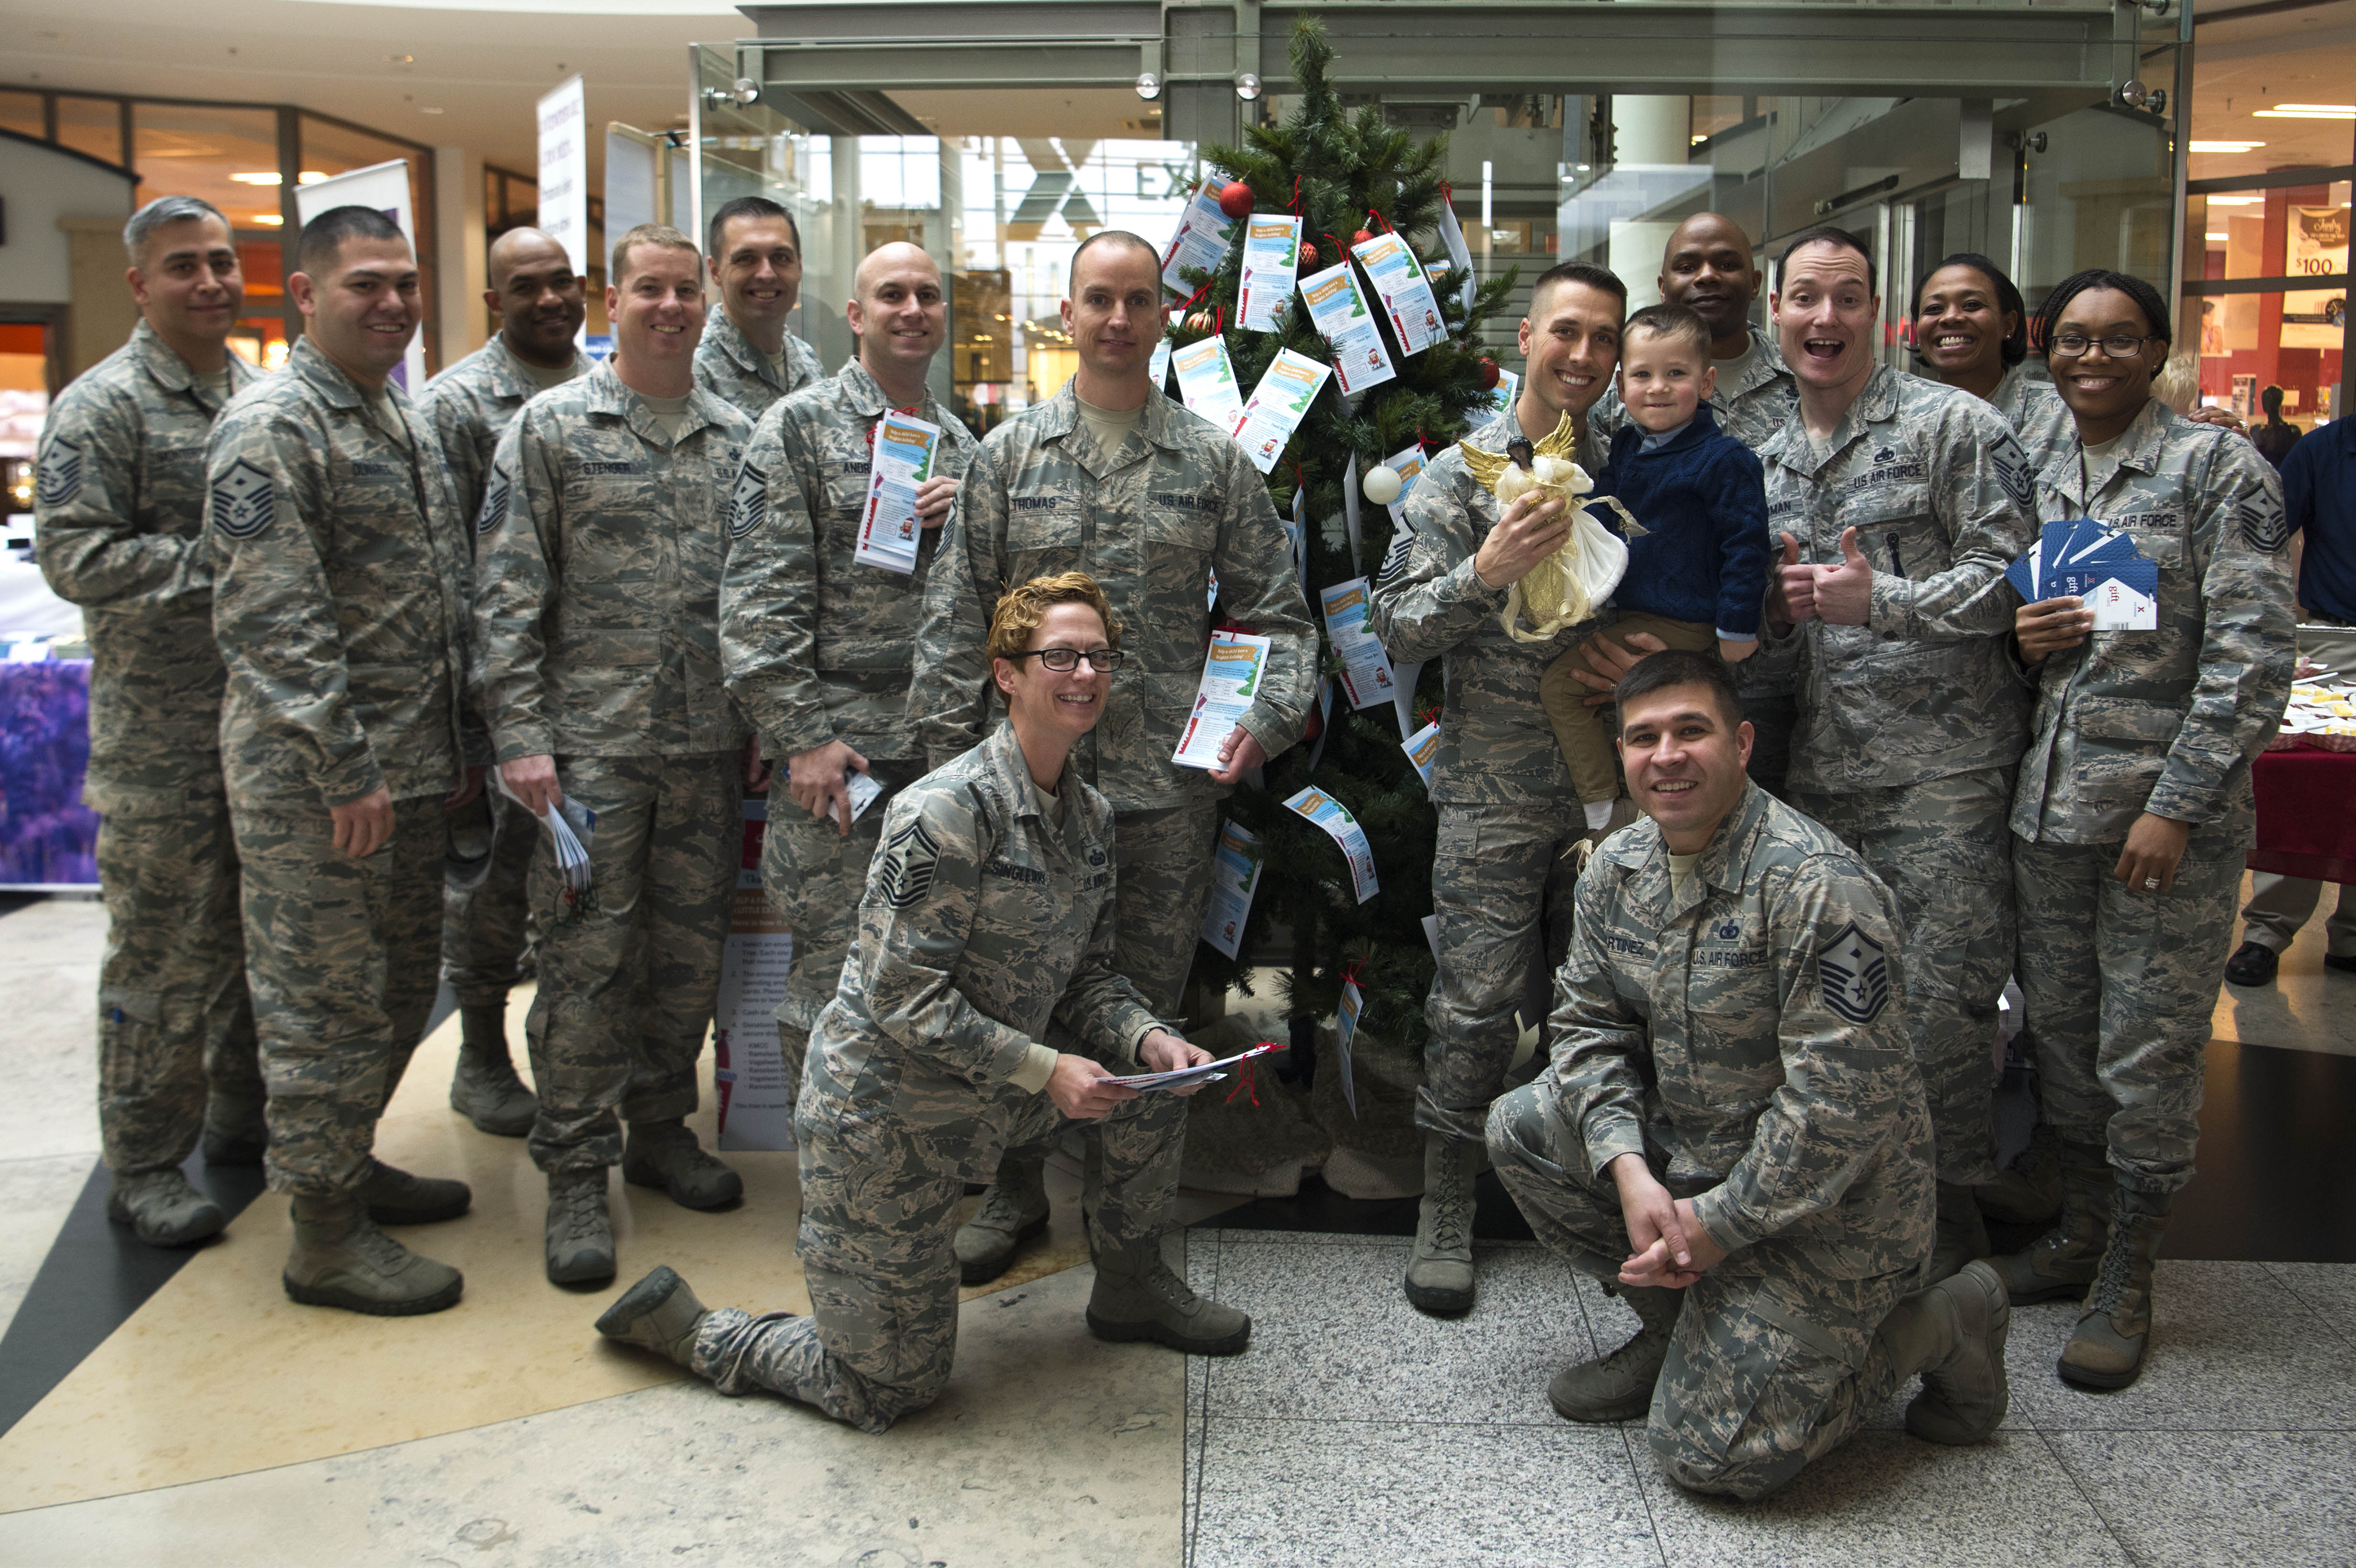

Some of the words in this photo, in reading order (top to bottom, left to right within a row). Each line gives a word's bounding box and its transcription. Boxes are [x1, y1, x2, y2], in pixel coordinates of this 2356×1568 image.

[844, 462, 872, 474] ANDR
[1870, 470, 1885, 483] AIR
[1887, 464, 1921, 479] FORCE
[1012, 497, 1056, 511] THOMAS
[1178, 496, 1194, 508] AIR
[1197, 497, 1220, 513] FORCE
[1769, 501, 1791, 516] MAN
[2121, 515, 2137, 527] AIR
[2139, 514, 2176, 527] FORCE
[2066, 577, 2078, 593] gift
[2108, 586, 2120, 602] gift
[1607, 936, 1644, 955] RTINEZ
[1709, 951, 1723, 966] AIR
[1724, 951, 1766, 967] FORCE
